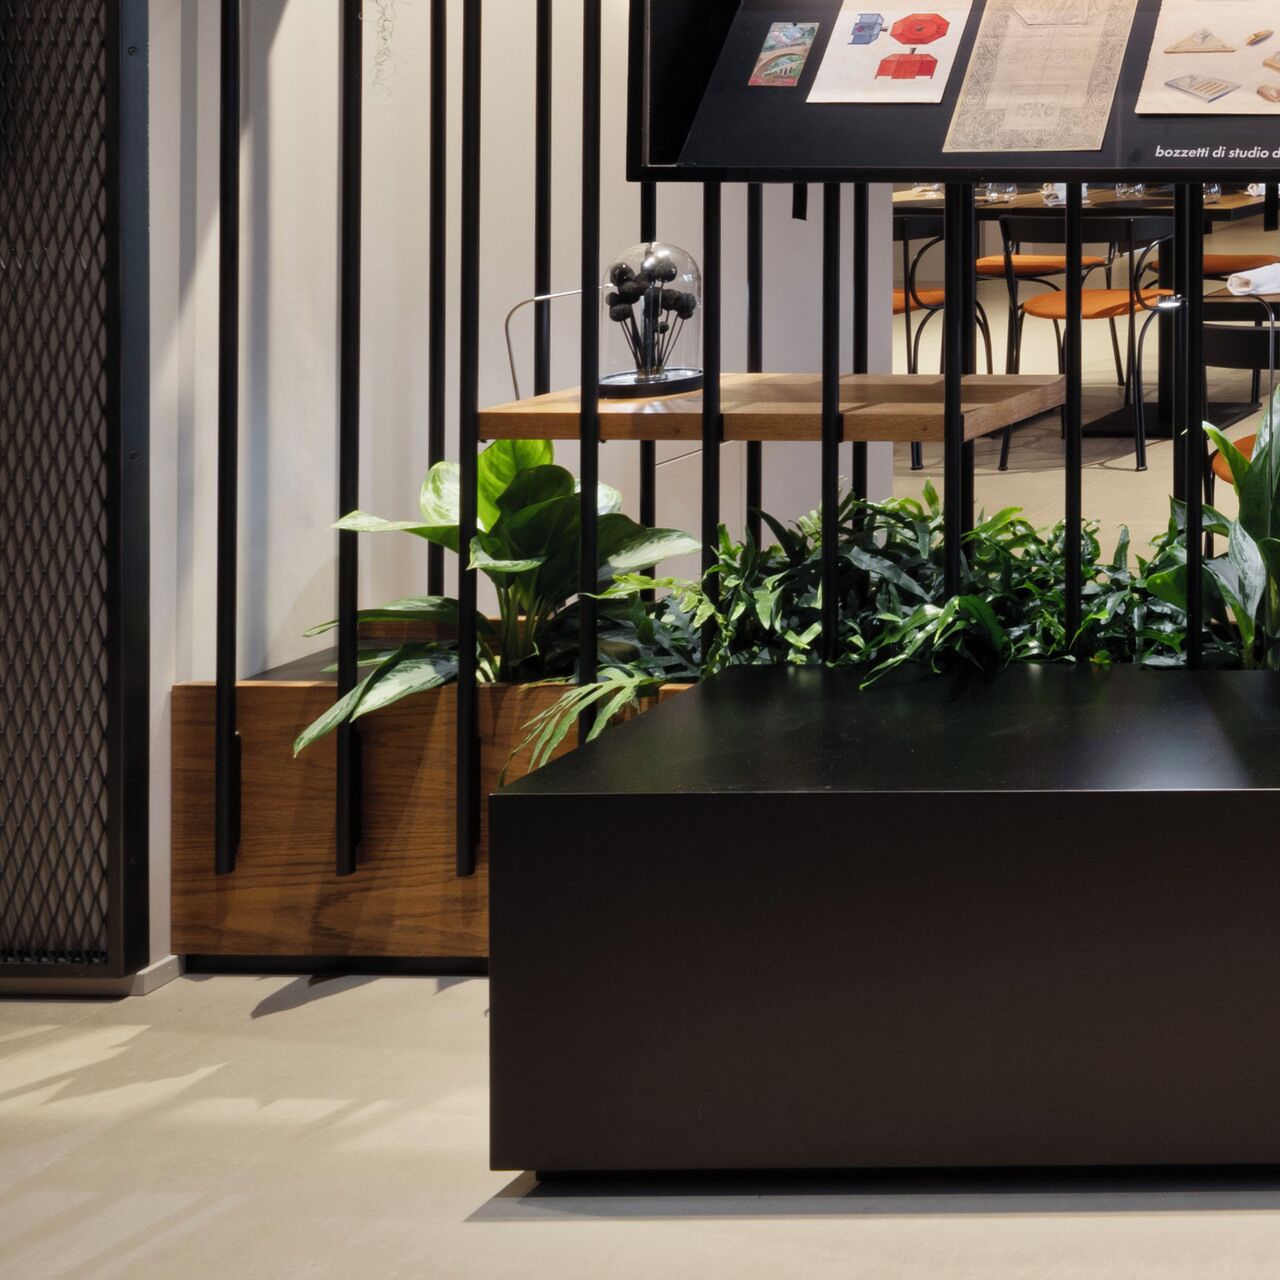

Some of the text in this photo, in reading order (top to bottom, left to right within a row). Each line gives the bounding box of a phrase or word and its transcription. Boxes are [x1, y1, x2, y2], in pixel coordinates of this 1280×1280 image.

[1154, 145, 1210, 158] bozzetti
[1211, 145, 1226, 158] di
[1228, 145, 1270, 159] studio
